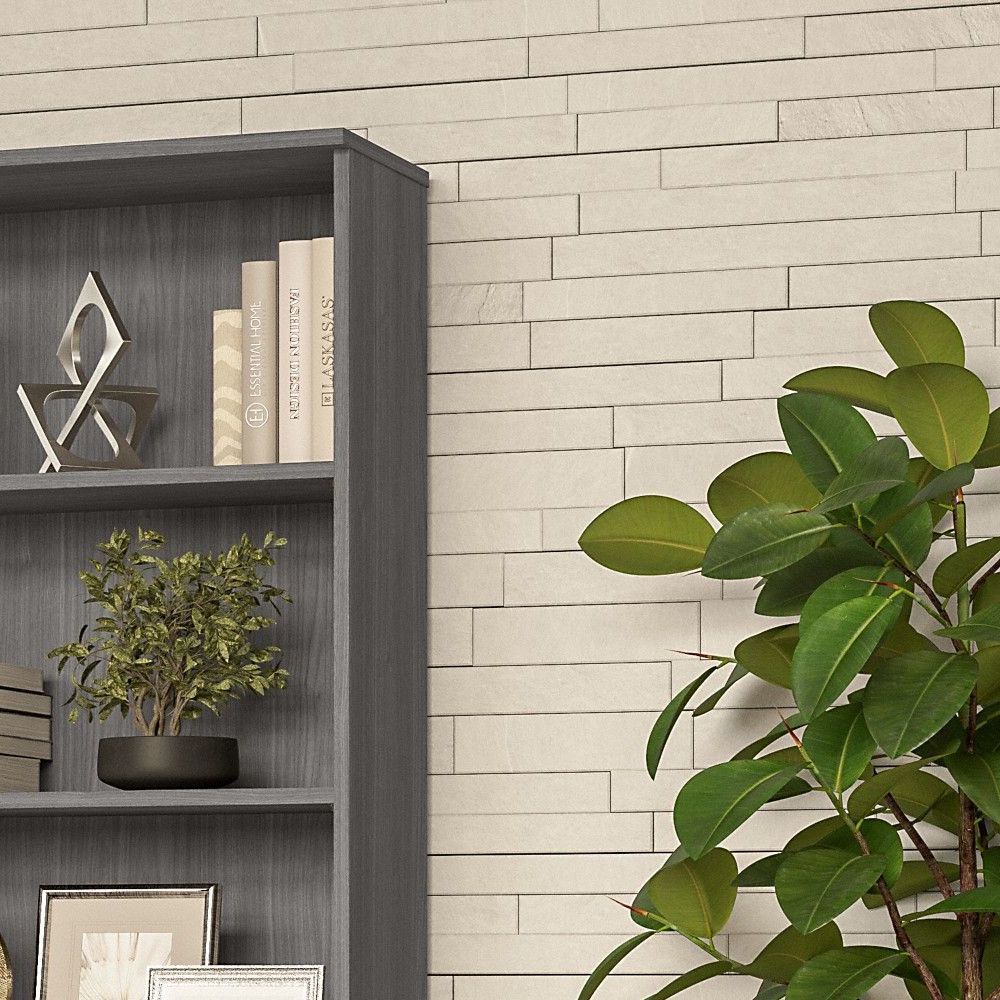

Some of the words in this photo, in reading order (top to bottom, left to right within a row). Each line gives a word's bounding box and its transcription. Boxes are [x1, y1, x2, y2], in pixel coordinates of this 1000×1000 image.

[250, 301, 262, 338] HOME
[289, 288, 300, 356] FASHION
[321, 297, 334, 389] LASKASAS
[250, 341, 261, 397] ESSENTIAL
[289, 361, 300, 420] DESIGN
